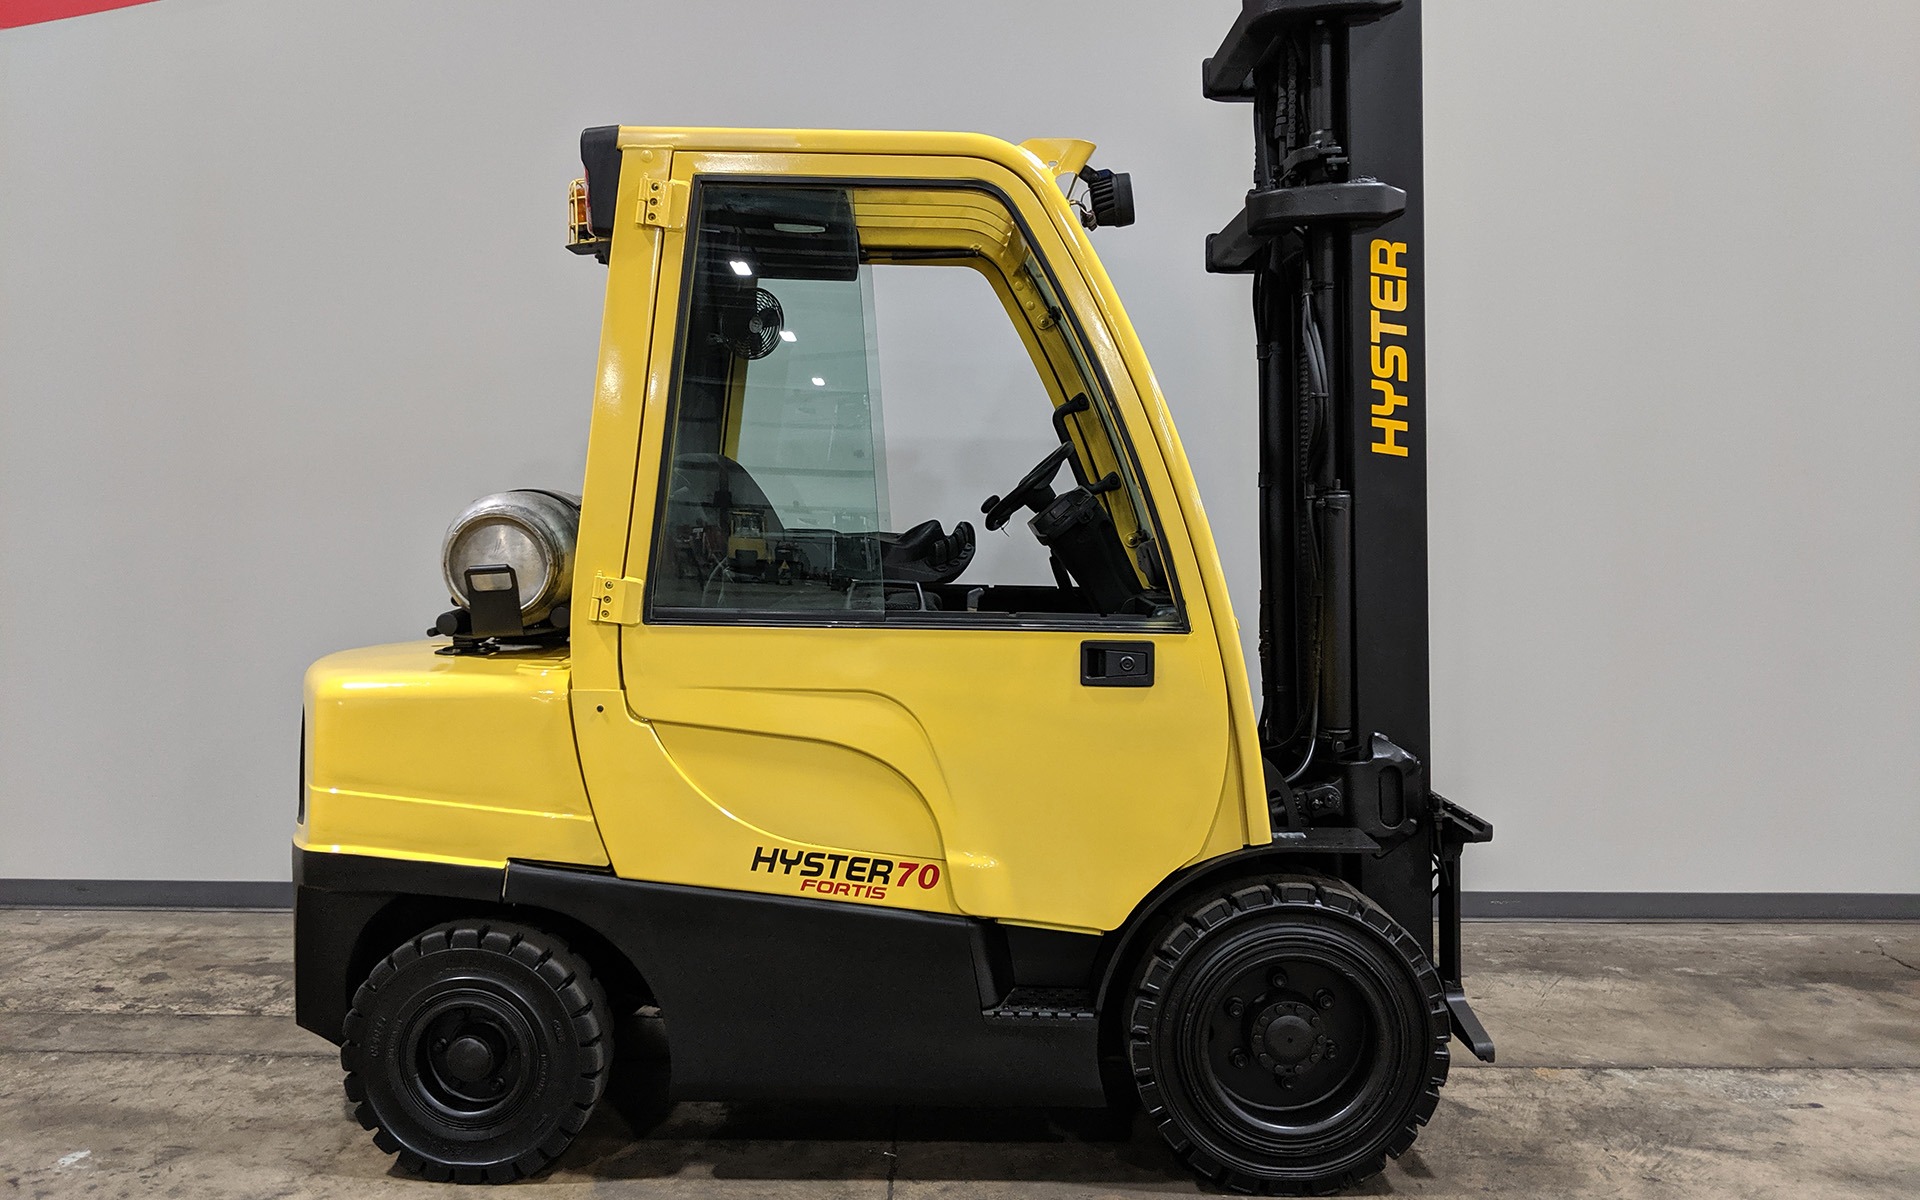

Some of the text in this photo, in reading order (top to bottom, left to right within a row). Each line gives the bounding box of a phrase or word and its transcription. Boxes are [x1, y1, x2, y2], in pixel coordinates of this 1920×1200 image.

[1370, 238, 1408, 458] HYSTER
[750, 846, 941, 890] HYSTER 70
[799, 879, 888, 900] FORTIS
